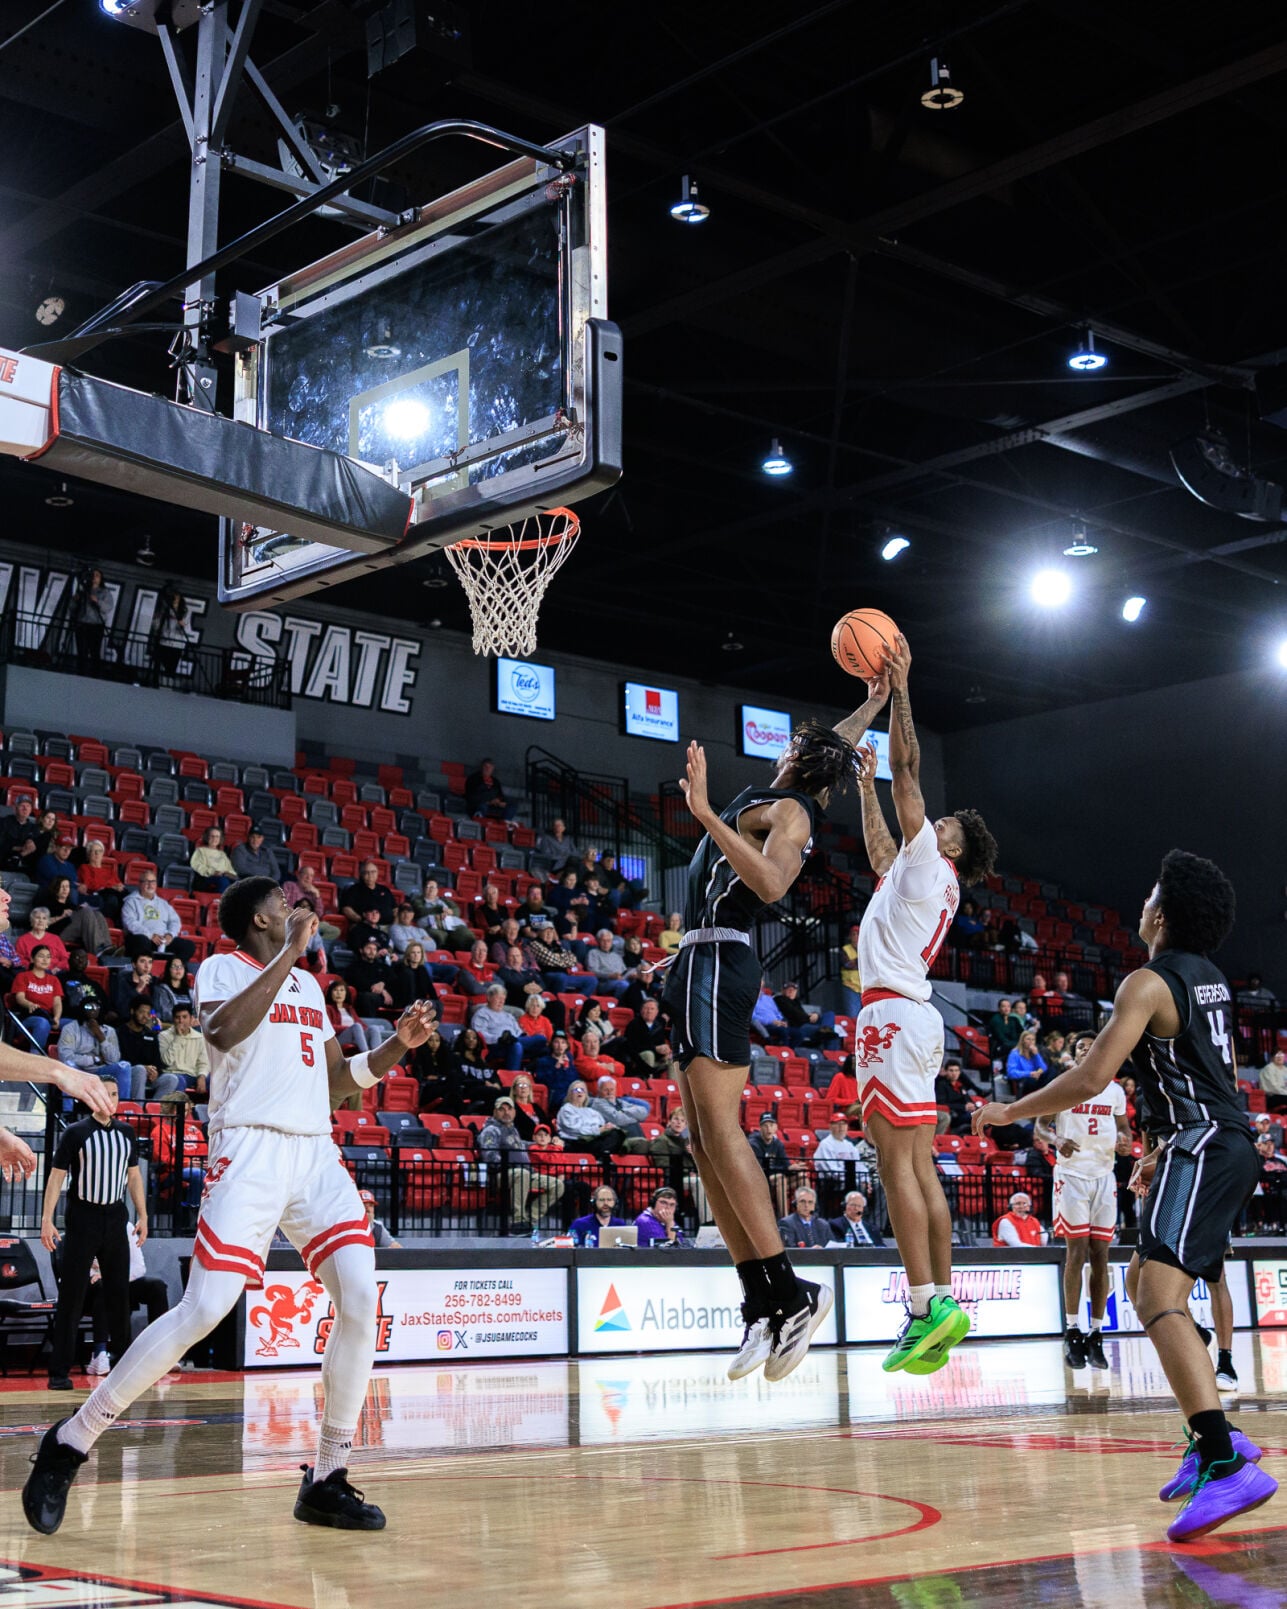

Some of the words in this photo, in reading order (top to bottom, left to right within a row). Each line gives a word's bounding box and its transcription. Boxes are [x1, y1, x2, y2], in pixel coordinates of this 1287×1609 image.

[232, 609, 422, 714] STATE
[269, 1003, 299, 1024] JAX
[1207, 1009, 1232, 1065] 4
[300, 1031, 315, 1068] 5
[1091, 1104, 1112, 1116] STATE
[1088, 1117, 1099, 1136] 2
[454, 1281, 468, 1290] FOR
[470, 1280, 496, 1290] TICKETS
[498, 1280, 513, 1290] CALL
[882, 1269, 1022, 1303] JAONVILLE
[444, 1293, 522, 1308] 256-782-8499
[400, 1309, 563, 1327] JaxStateSports.com/tickets
[640, 1297, 744, 1330] Alabama
[475, 1331, 538, 1343] @JSUGAMECOCKS
